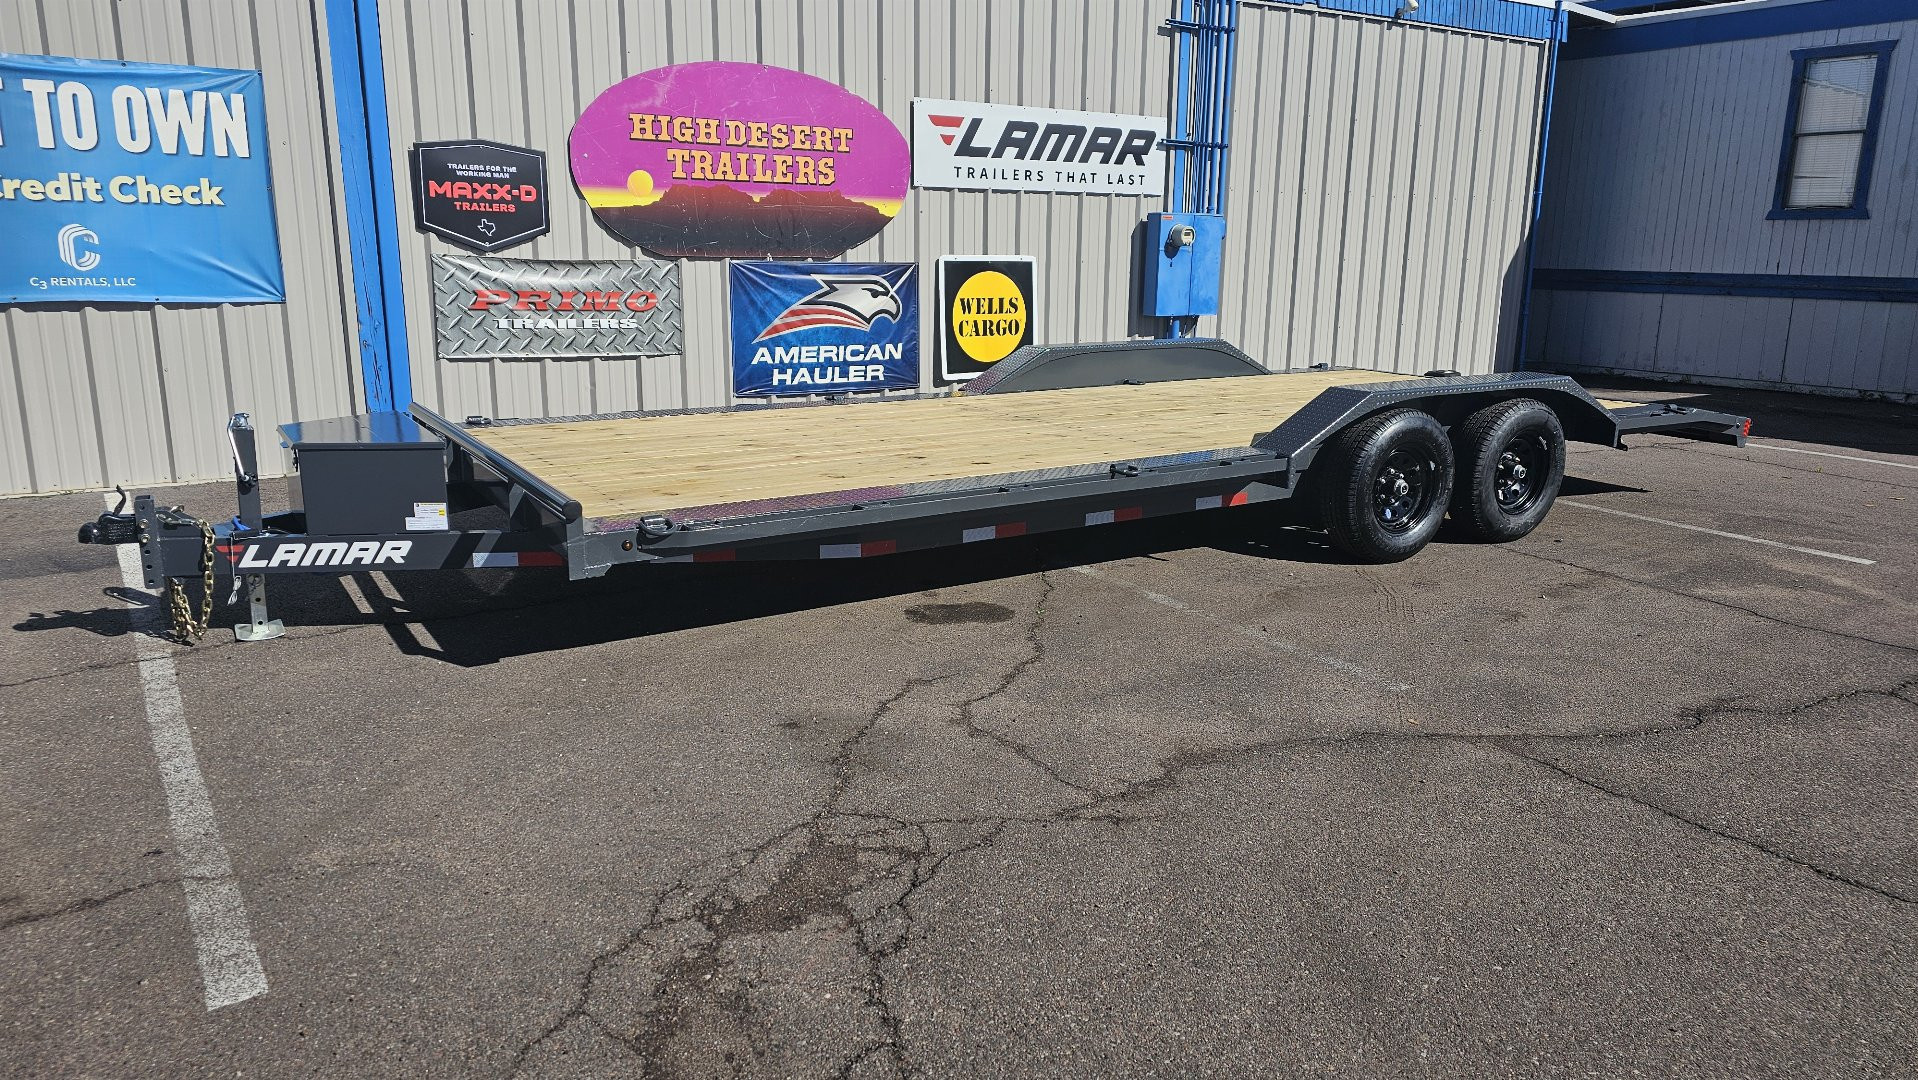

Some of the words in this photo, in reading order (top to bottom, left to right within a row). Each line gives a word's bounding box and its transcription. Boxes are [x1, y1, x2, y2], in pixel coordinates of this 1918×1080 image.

[22, 78, 98, 151] TO
[111, 85, 250, 158] OWN
[628, 112, 722, 145] HIGH
[725, 119, 854, 153] DESERT
[953, 117, 1158, 167] LAMAR
[447, 163, 485, 172] TRAILERS
[502, 165, 517, 173] THE
[456, 169, 491, 178] WORKING
[493, 171, 510, 179] MAN
[666, 148, 837, 186] TRAILERS
[953, 166, 1044, 182] TRAILERS
[1055, 171, 1098, 184] THAT
[1107, 172, 1146, 187] LAST
[0, 172, 104, 202] redit
[109, 175, 226, 206] Check
[428, 180, 537, 202] MAXX-D
[454, 201, 516, 213] TRAILERS
[50, 276, 111, 288] RENTALS,
[113, 277, 137, 287] LLC
[467, 288, 659, 313] PRIMO
[959, 296, 1019, 315] WELLS
[494, 318, 638, 330] TRAILERS
[958, 318, 1020, 337] CARGO
[750, 342, 903, 365] AMERICAN
[772, 364, 885, 386] HAULER
[238, 540, 413, 569] LAMAR
